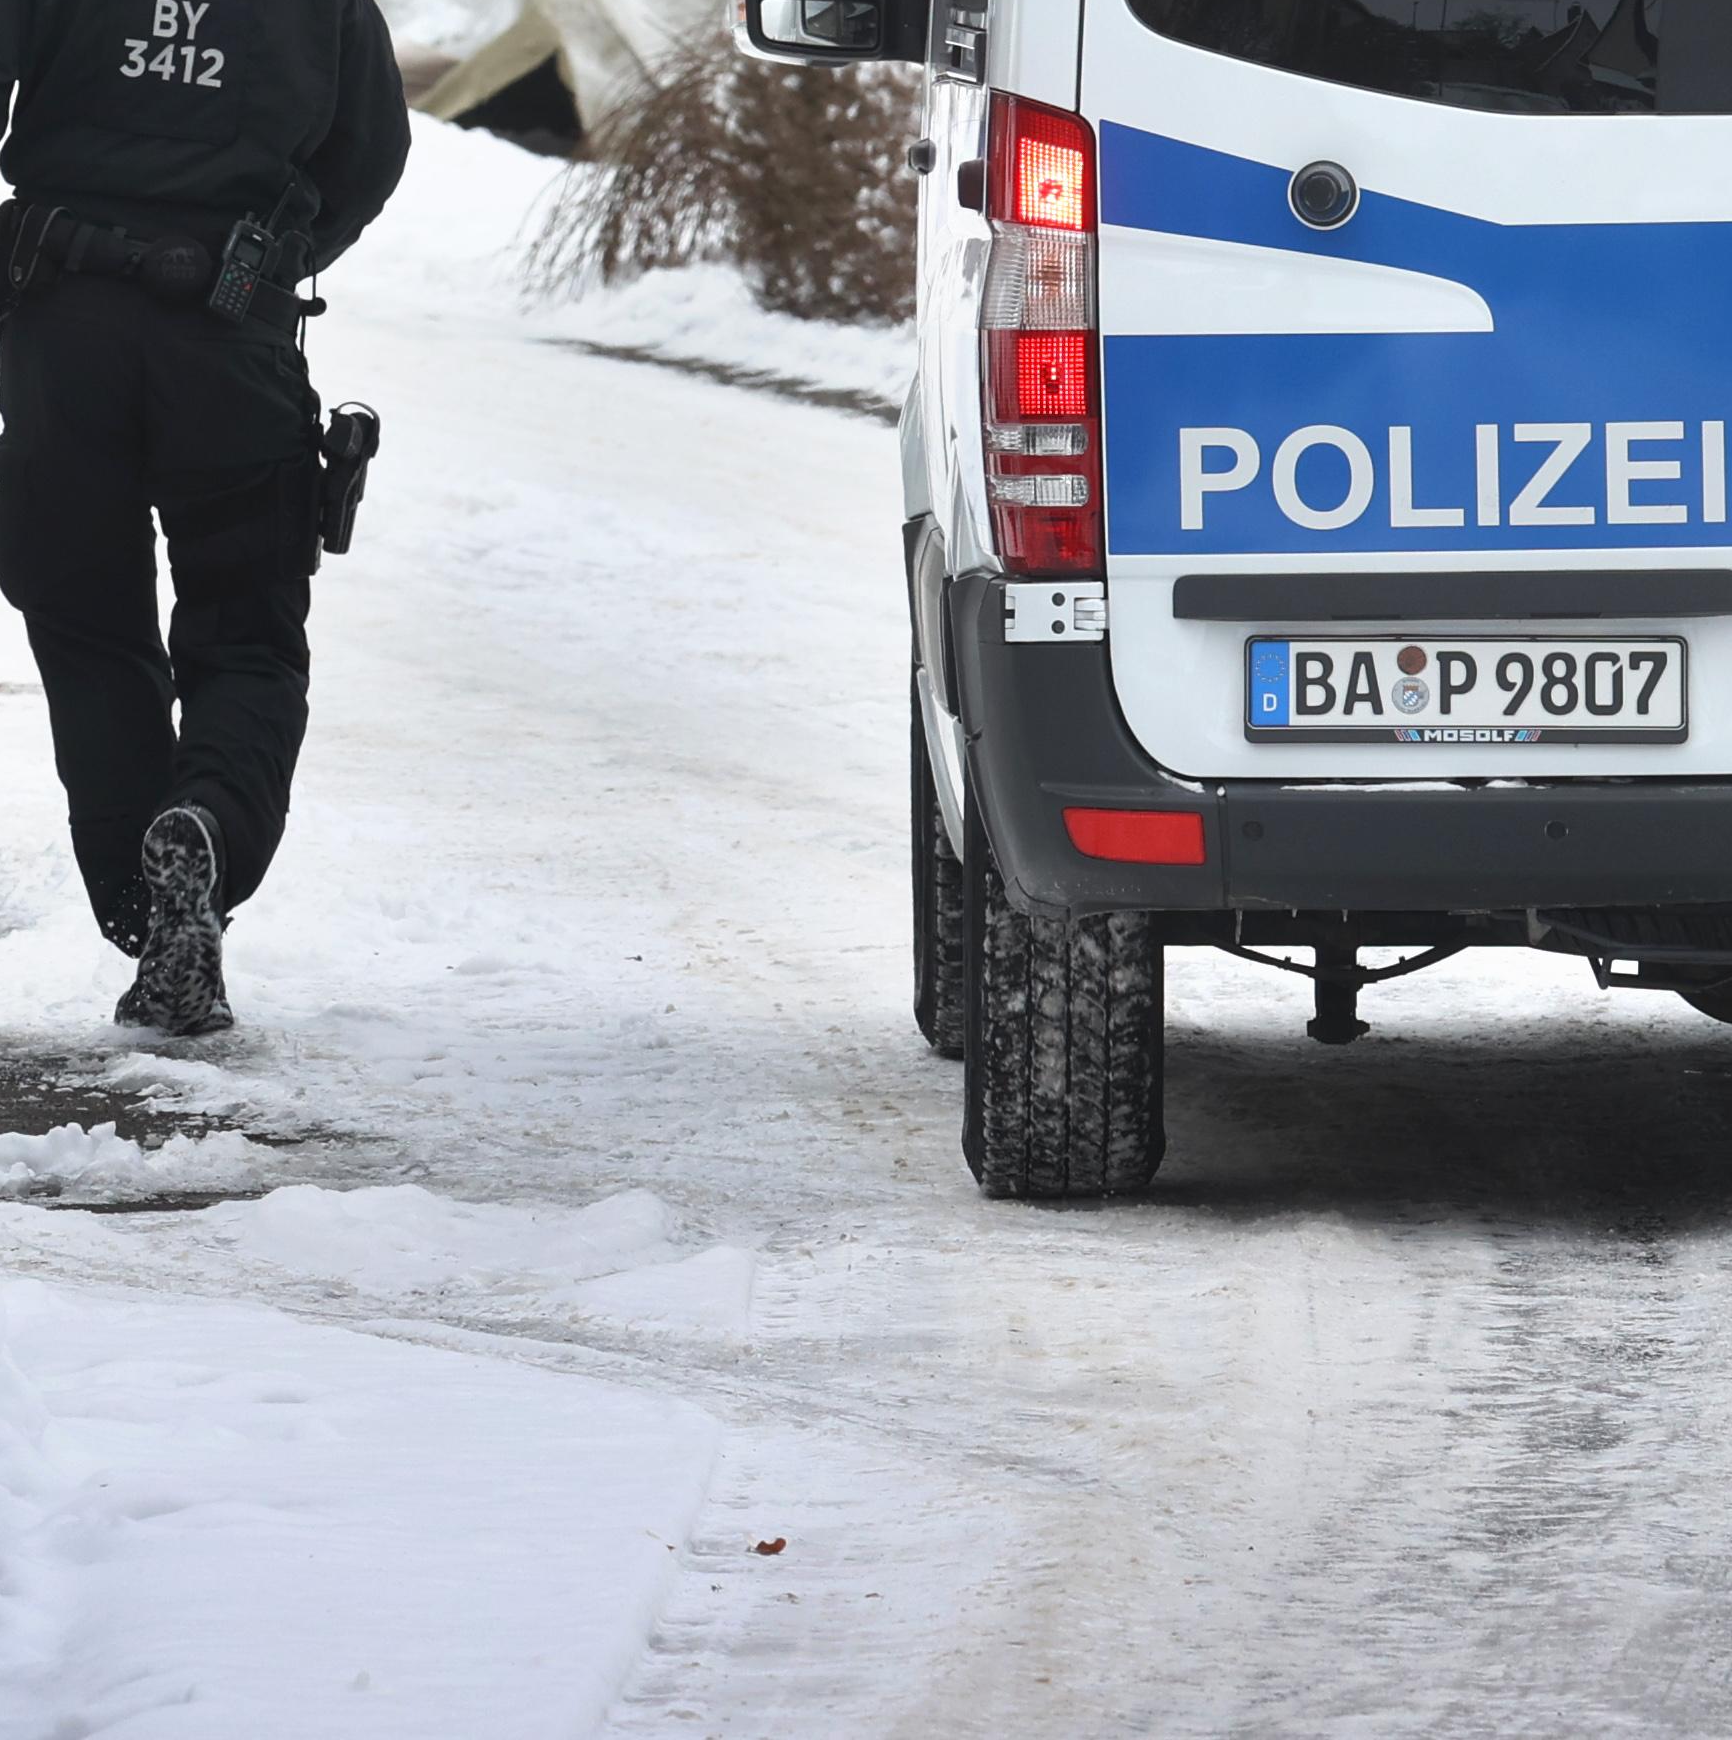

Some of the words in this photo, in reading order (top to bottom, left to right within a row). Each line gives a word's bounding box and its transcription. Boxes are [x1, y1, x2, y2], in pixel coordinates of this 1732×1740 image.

[119, 38, 225, 88] 3412
[1179, 420, 1727, 531] POLIZEI
[1263, 694, 1277, 712] D
[1295, 651, 1384, 716] BA
[1436, 651, 1478, 716] P
[1495, 651, 1668, 716] 9807
[1423, 729, 1516, 742] MOSOLF
